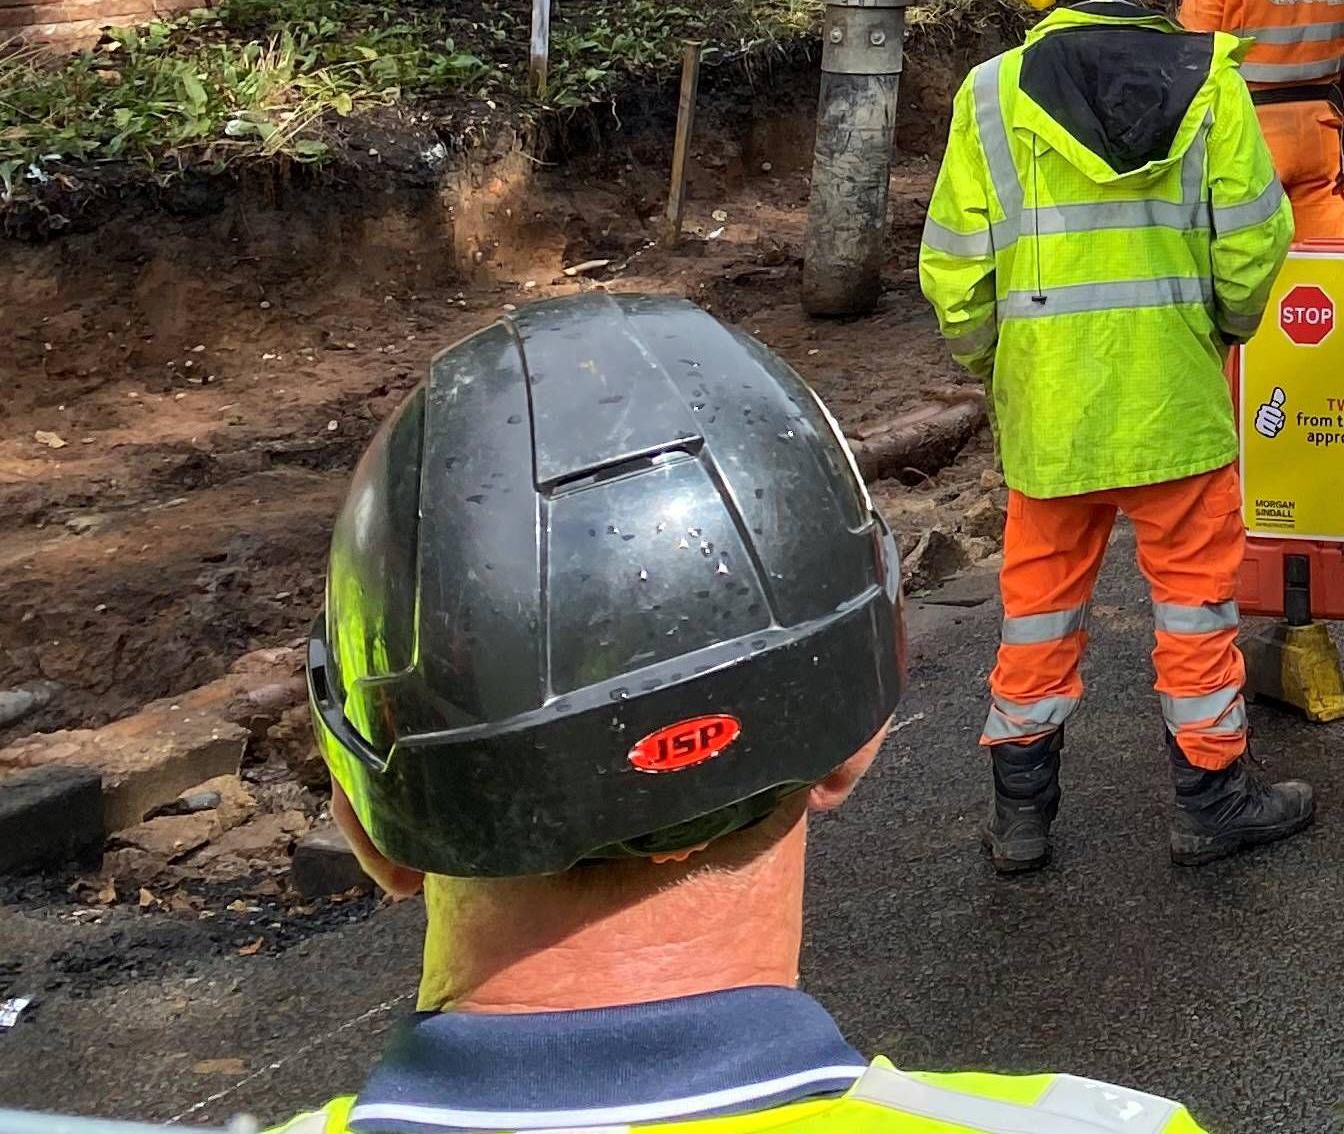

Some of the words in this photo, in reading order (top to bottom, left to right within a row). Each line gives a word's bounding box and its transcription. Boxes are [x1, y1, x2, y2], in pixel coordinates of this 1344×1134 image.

[1282, 306, 1333, 325] STOP
[1297, 413, 1333, 427] from
[1255, 499, 1295, 509] MORGAN
[648, 721, 725, 766] JSP
